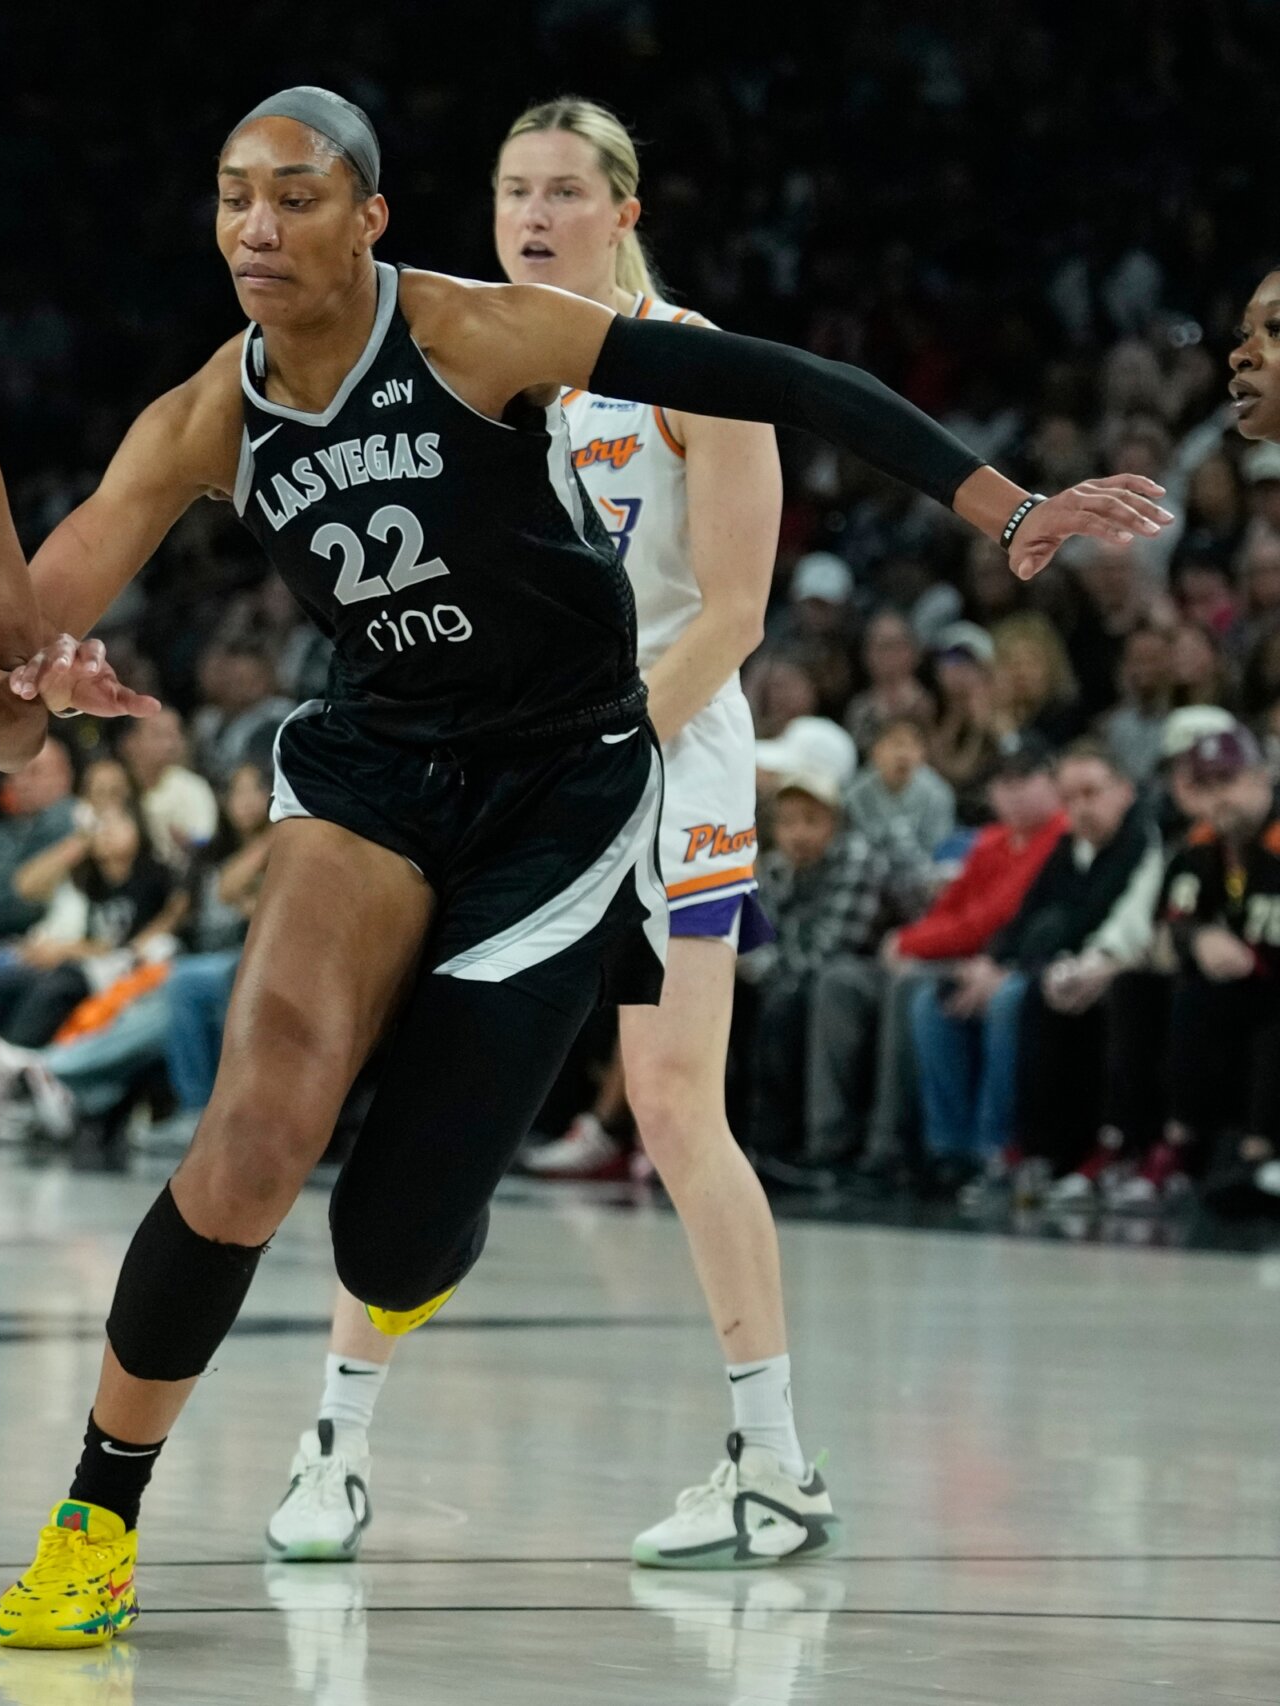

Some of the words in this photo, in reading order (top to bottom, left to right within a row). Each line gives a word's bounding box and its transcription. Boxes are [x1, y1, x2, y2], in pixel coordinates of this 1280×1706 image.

[372, 379, 413, 408] ally
[256, 457, 327, 531] LAS
[314, 432, 444, 490] VEGAS
[1003, 501, 1033, 540] RENEW
[310, 504, 451, 606] 22
[367, 604, 473, 652] ring
